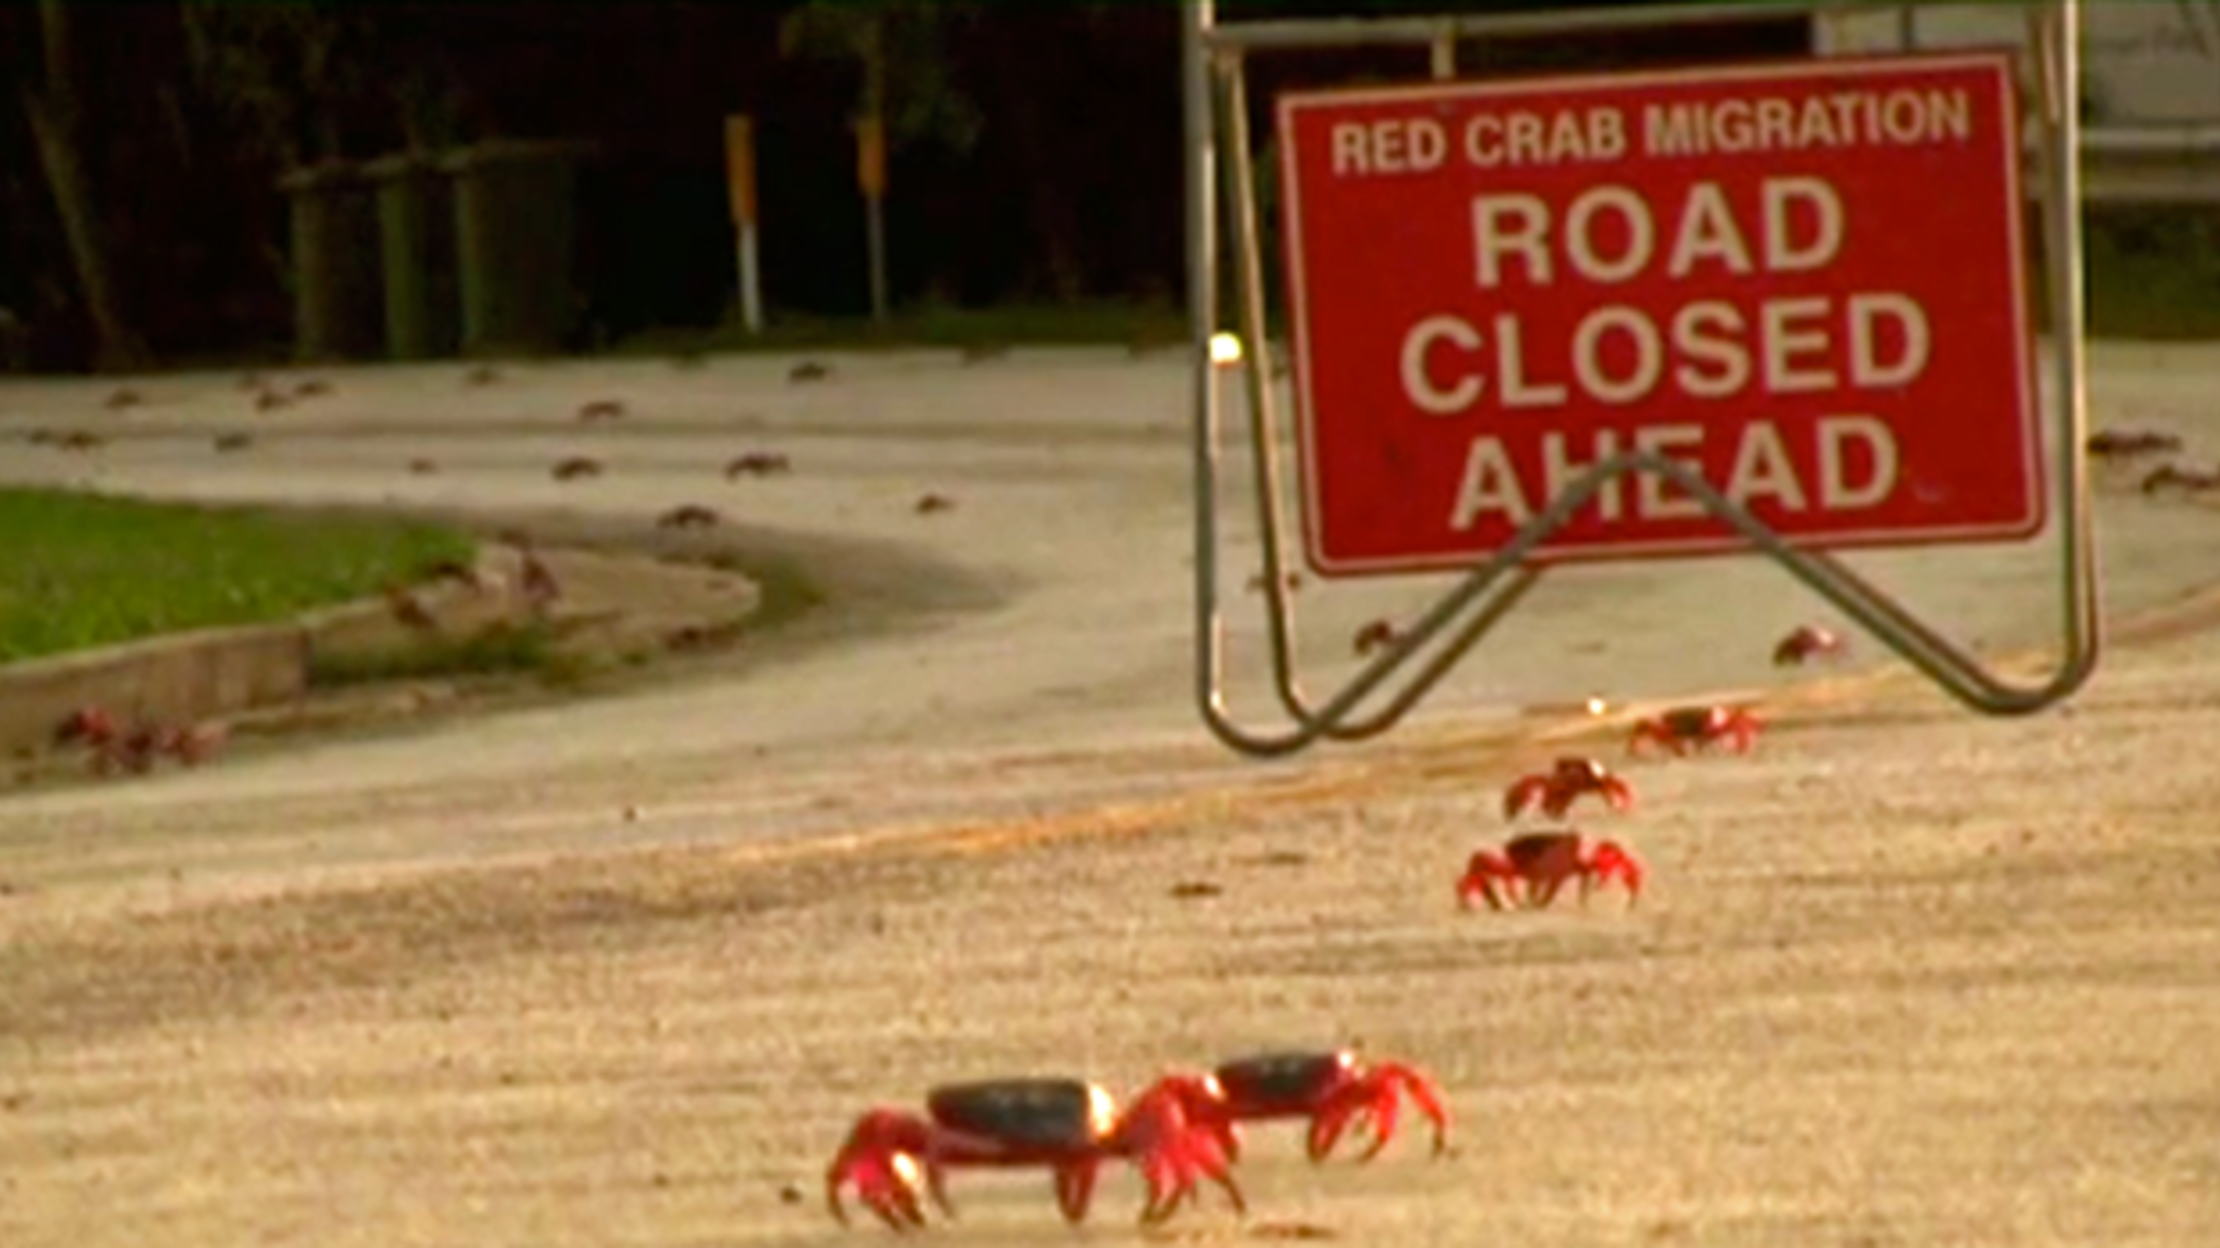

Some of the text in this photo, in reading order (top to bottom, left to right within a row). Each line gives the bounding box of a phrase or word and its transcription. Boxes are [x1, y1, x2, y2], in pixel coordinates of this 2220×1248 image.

[1332, 90, 1970, 175] RED CRAB MIGRATION
[1473, 177, 1845, 288] ROAD
[1400, 293, 1931, 413] CLOSED
[1451, 414, 1899, 531] AHEAD
